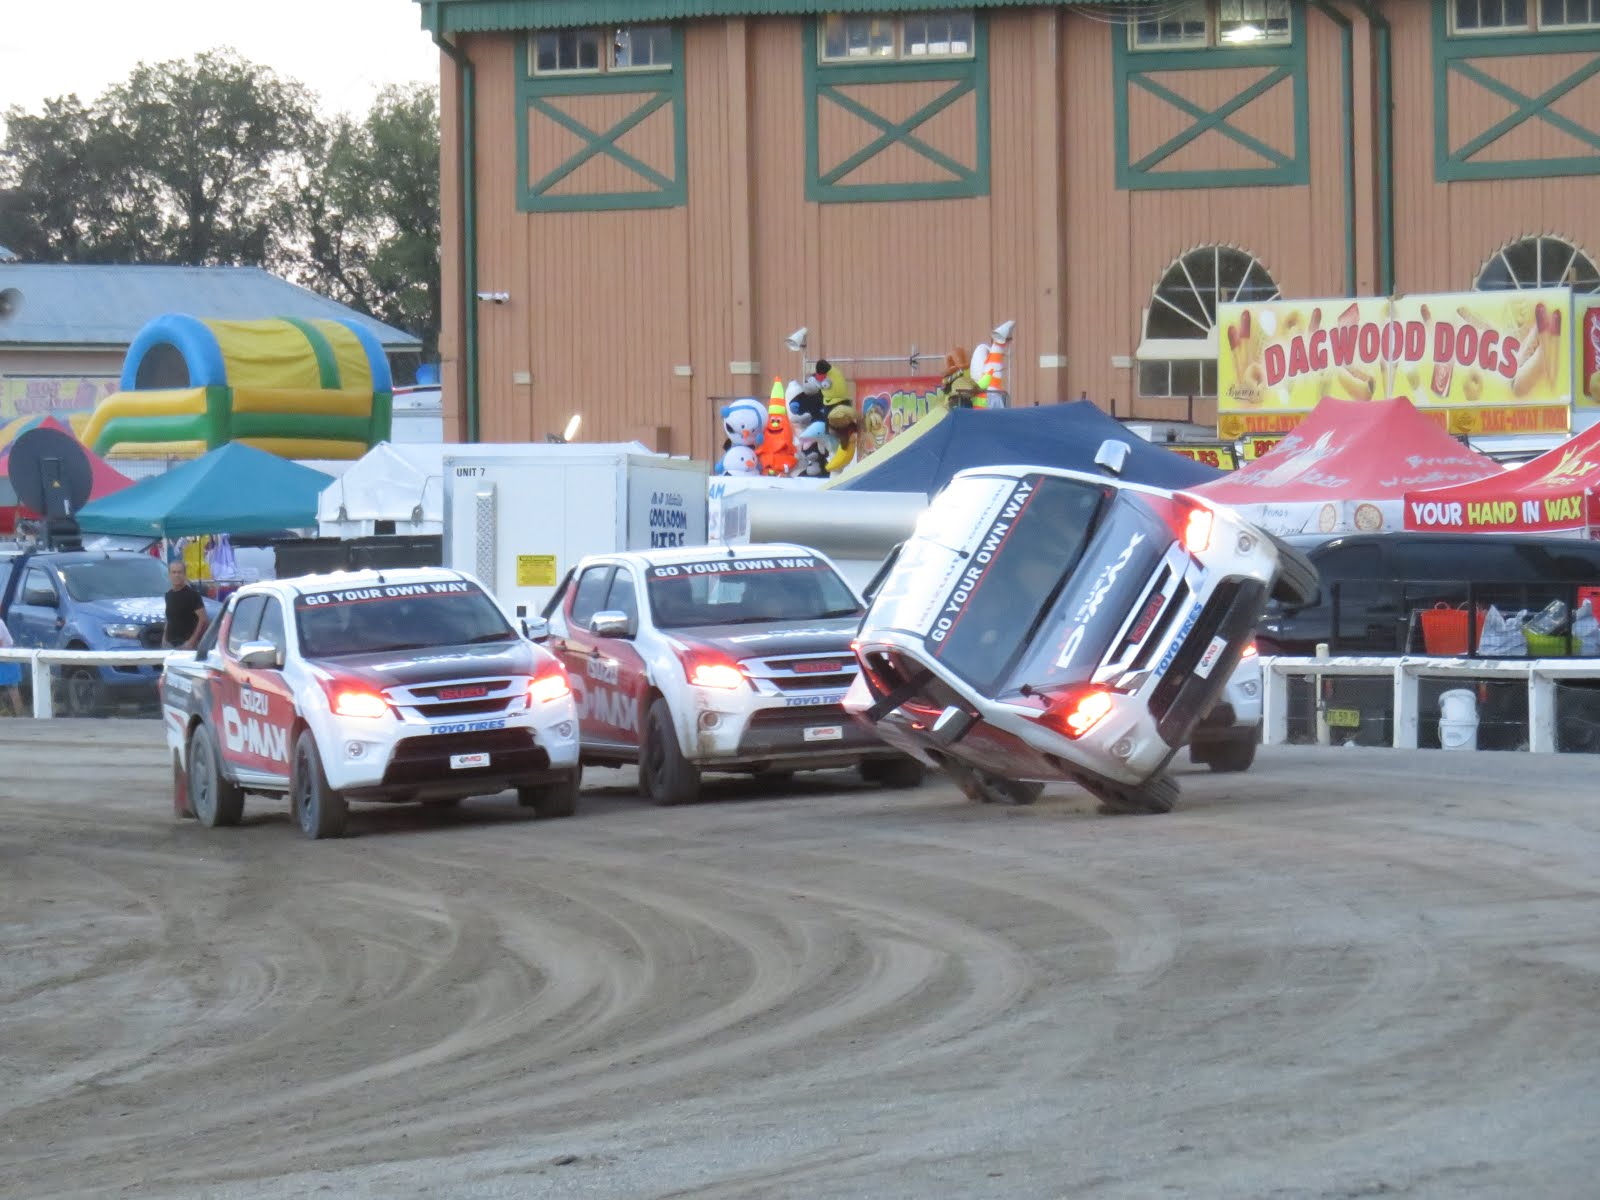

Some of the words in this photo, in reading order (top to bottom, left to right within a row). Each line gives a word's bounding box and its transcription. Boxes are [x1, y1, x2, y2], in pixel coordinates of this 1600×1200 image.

[1264, 320, 1426, 387] DAGWOOD
[1433, 321, 1521, 380] DOGS
[456, 467, 477, 477] UNIT
[480, 468, 486, 477] 7
[649, 508, 687, 529] COOLROOM
[1411, 502, 1462, 526] YOUR
[1467, 501, 1517, 525] HAND
[1521, 500, 1540, 524] IN
[1544, 496, 1582, 522] WAX
[650, 531, 684, 548] HIRE
[655, 566, 679, 577] GO
[682, 561, 732, 574] YOUR
[734, 558, 775, 571] OWN
[777, 557, 815, 568] WAY
[931, 617, 952, 642] GO
[946, 566, 984, 613] YOUR
[976, 522, 1010, 564] OWN
[1002, 481, 1034, 518] WAY
[305, 594, 330, 606] GO
[333, 588, 383, 602] YOUR
[385, 584, 428, 597] OWN
[431, 582, 468, 593] WAY
[1154, 640, 1180, 677] TOYO
[1177, 601, 1203, 642] TIRES
[240, 686, 269, 716] ISUZU
[440, 688, 486, 699] ISUZU
[785, 696, 820, 707] TOYO
[822, 694, 846, 705] TIR
[221, 704, 289, 764] D-MAX
[430, 722, 466, 734] TOYO
[468, 719, 506, 732] TIRES
